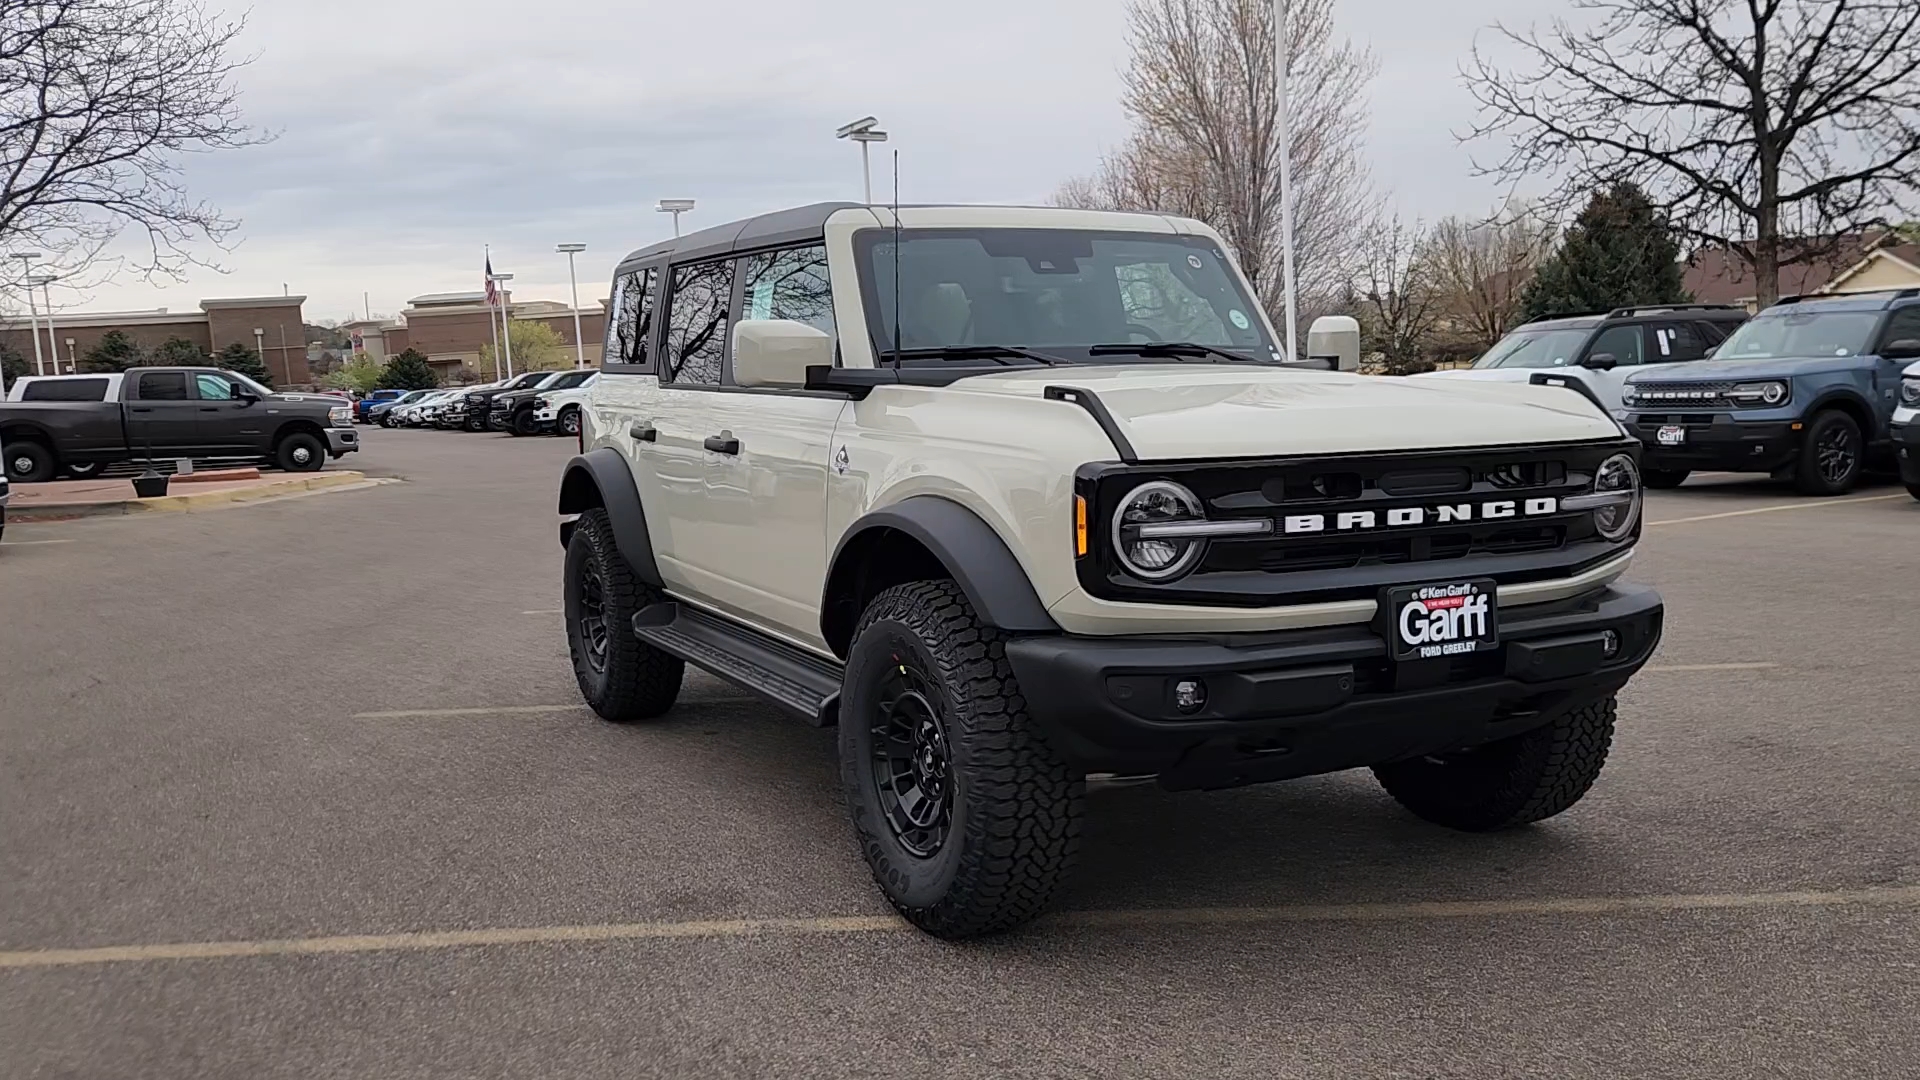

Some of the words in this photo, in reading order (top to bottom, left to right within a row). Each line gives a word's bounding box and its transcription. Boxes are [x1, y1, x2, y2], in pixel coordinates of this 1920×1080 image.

[1657, 428, 1685, 442] Garff
[1284, 497, 1557, 534] BRONCO
[1428, 586, 1447, 598] Ken
[1447, 583, 1471, 596] Garff
[1400, 594, 1488, 645] Garff
[1420, 645, 1442, 658] FORD
[1442, 641, 1477, 655] GREELEY
